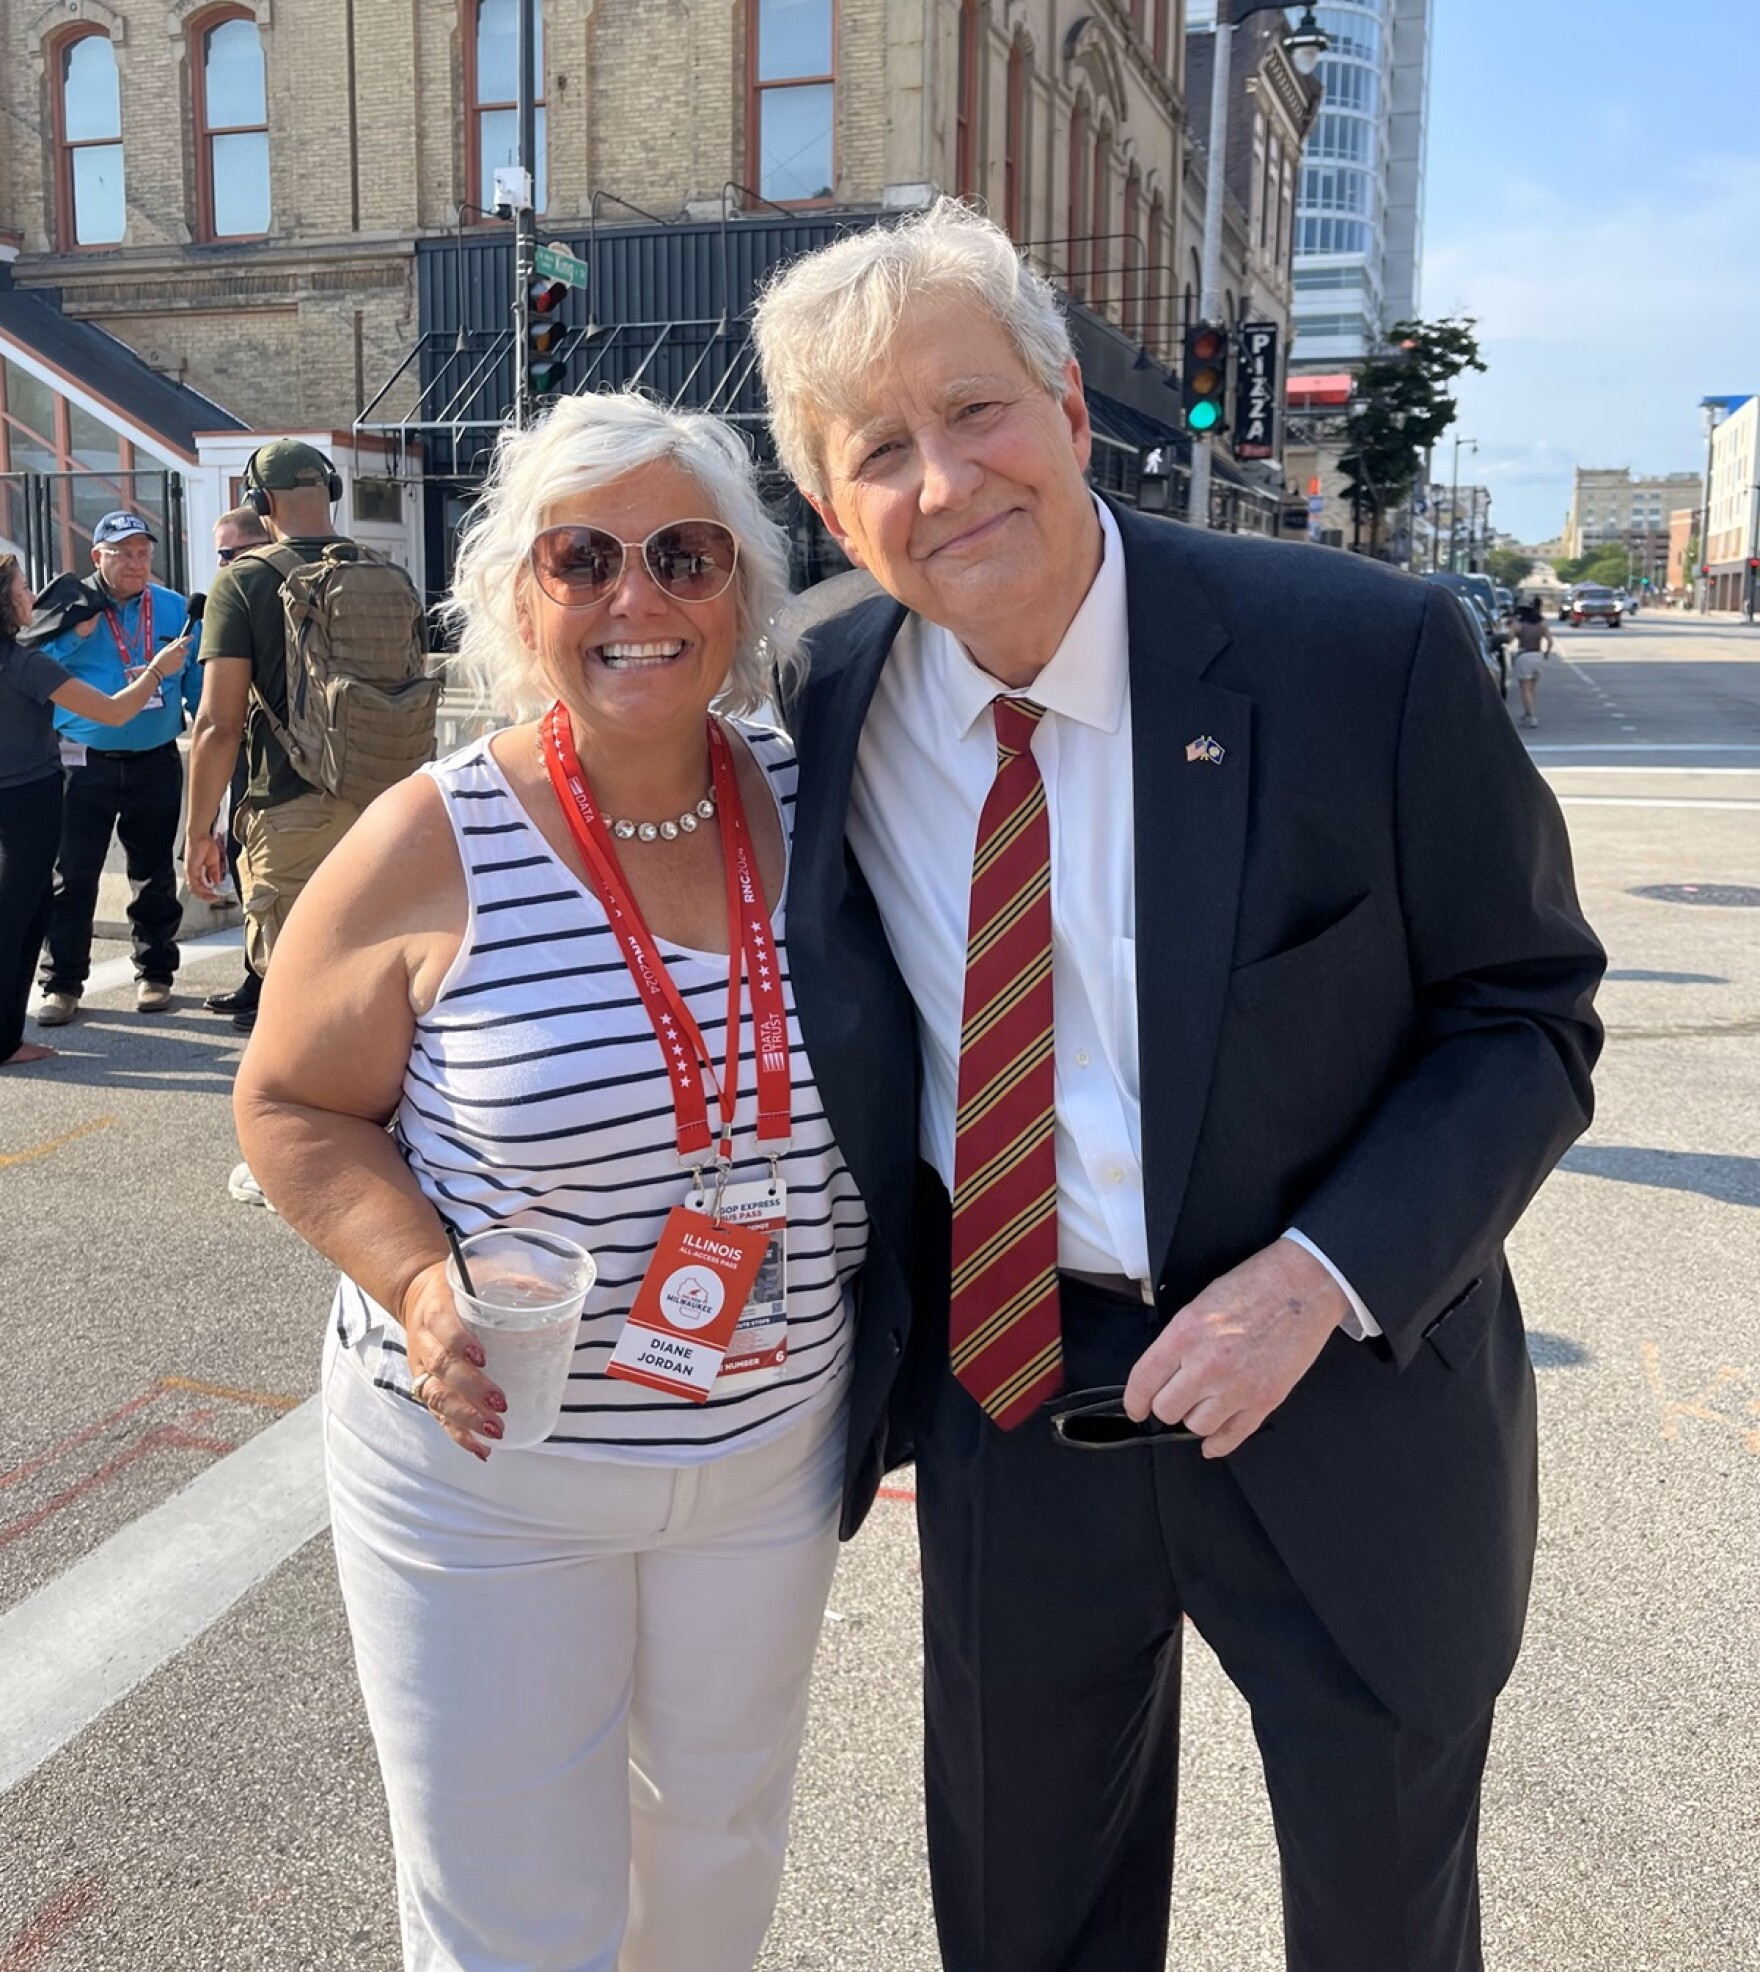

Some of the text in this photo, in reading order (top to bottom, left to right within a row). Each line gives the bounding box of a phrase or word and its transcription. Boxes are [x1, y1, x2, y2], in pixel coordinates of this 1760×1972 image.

[555, 254, 575, 284] King
[1246, 333, 1271, 440] PIZZA
[574, 793, 595, 824] DATA
[760, 1020, 772, 1053] DATA
[769, 1012, 783, 1052] TRUST
[721, 1209, 762, 1222] US PASS
[741, 1198, 781, 1212] EXPRESS
[679, 1246, 738, 1271] ALL-ACCESS PASS
[682, 1232, 743, 1262] ILLINOIS
[666, 1293, 713, 1314] MILWAUKEE
[650, 1337, 693, 1360] DIANE
[725, 1358, 760, 1371] NUMBER
[775, 1350, 786, 1363] 6
[637, 1352, 694, 1376] JORDAN
